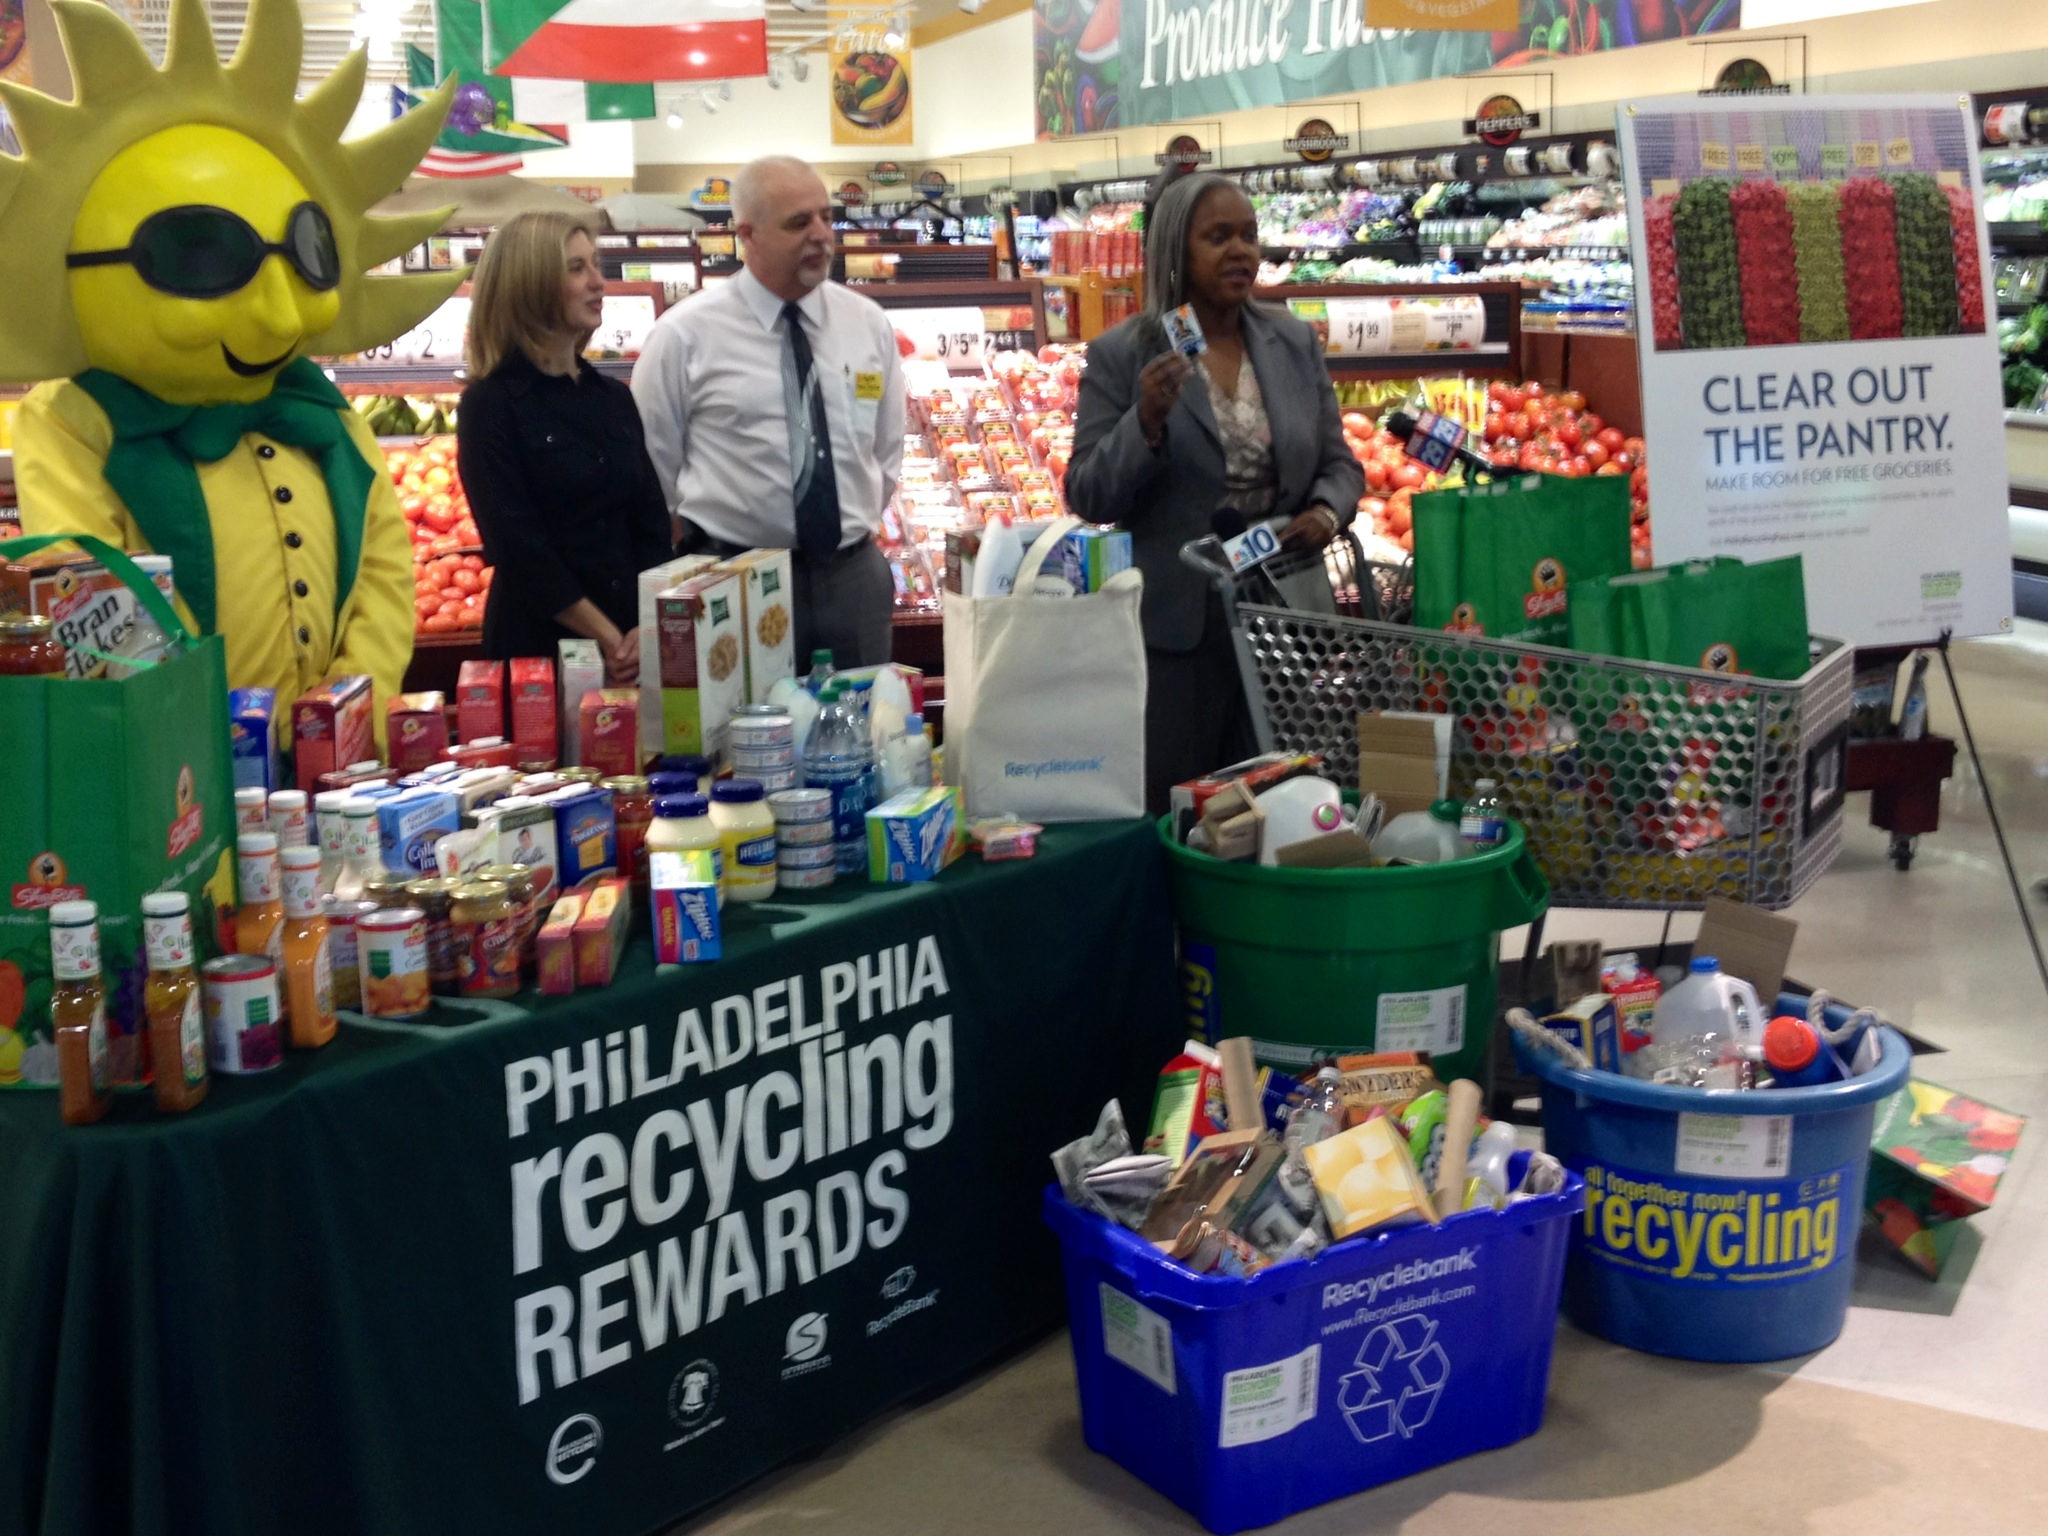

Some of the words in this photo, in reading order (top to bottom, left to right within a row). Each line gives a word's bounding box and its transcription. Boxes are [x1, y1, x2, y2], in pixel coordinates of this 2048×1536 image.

[1139, 0, 1292, 89] Produce
[1285, 136, 1348, 151] MUSHROOMS
[1475, 113, 1531, 134] PEPPERS
[1702, 369, 1836, 416] CLEAR
[1847, 363, 1934, 406] OUT
[1703, 423, 1785, 466] THE
[1796, 412, 1954, 461] PANTRY.
[1705, 474, 1748, 492] MAKE
[1752, 471, 1799, 490] ROOM
[1802, 469, 1832, 486] FOR
[1835, 466, 1870, 484] FREE
[1241, 529, 1275, 560] 10
[57, 594, 120, 648] Bran
[1004, 757, 1104, 779] Recyclebank
[678, 890, 715, 941] Ziploc
[510, 1014, 955, 1277] recycling
[1583, 1165, 1605, 1188] all
[1606, 1171, 1690, 1207] together
[1692, 1189, 1748, 1213] now!
[1583, 1187, 1840, 1279] recycling
[513, 1149, 910, 1408] REWARDS
[1321, 1246, 1479, 1310] Recyclebank
[1320, 1285, 1477, 1337] www.Recyclebank.com
